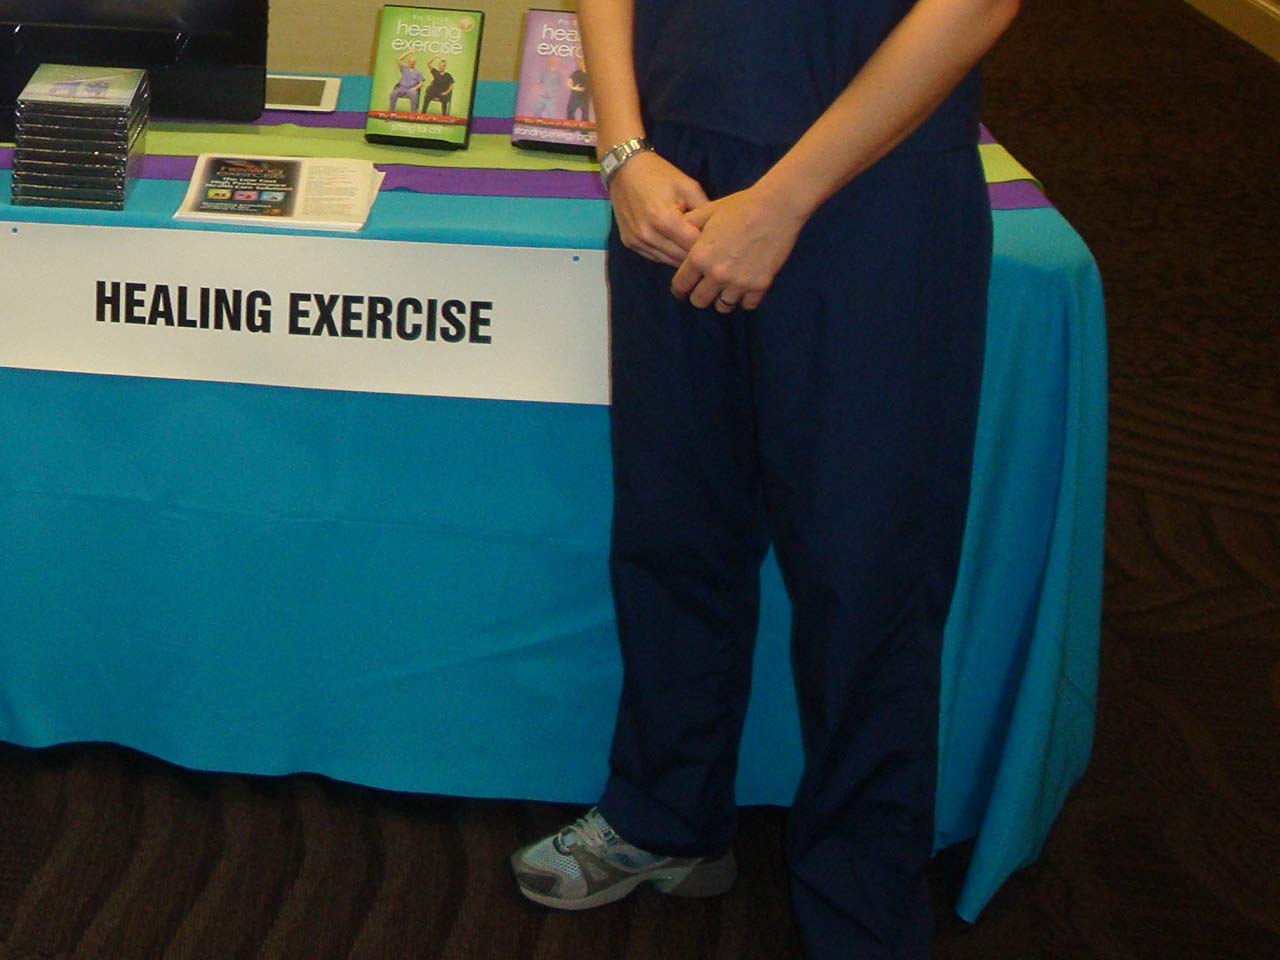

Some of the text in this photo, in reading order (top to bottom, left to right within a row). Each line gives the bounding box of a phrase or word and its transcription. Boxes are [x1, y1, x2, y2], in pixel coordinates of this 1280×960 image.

[396, 19, 462, 43] healing
[391, 37, 464, 55] exercise
[95, 279, 494, 345] HEALING EXERCISE
